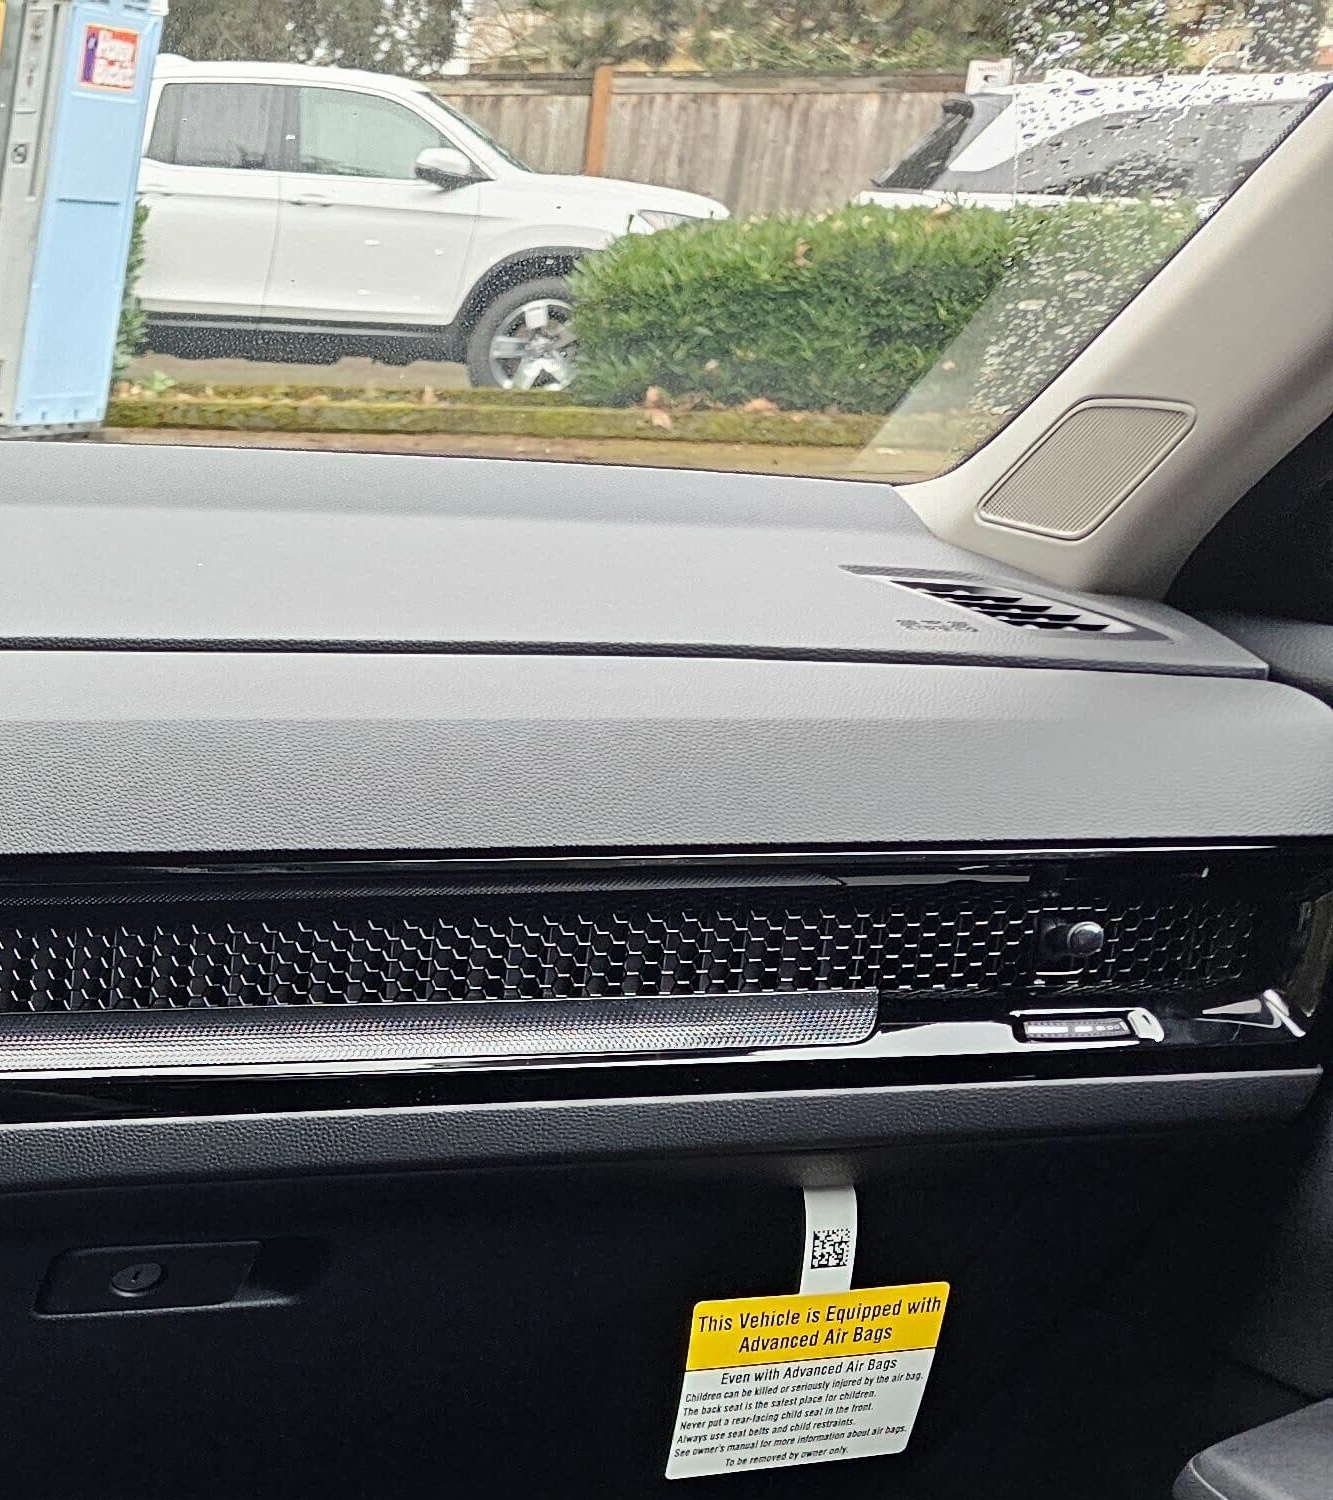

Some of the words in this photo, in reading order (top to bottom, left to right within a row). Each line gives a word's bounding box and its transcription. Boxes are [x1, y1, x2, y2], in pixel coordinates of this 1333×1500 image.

[699, 1315, 732, 1332] This
[740, 1309, 800, 1328] Vehicle
[807, 1308, 820, 1323] is
[826, 1300, 902, 1324] Equipped
[908, 1296, 941, 1314] with
[739, 1330, 819, 1353] Advanced
[823, 1329, 848, 1345] Air
[853, 1327, 892, 1343] Bags
[721, 1373, 750, 1384] Even
[755, 1368, 779, 1381] with
[783, 1362, 843, 1379] Advanced
[846, 1360, 864, 1372] Air
[868, 1359, 897, 1371] Bags
[686, 1392, 721, 1402] Children
[724, 1390, 738, 1398] can
[754, 1385, 778, 1396] killed
[791, 1381, 830, 1392] seriously
[832, 1378, 861, 1389] injured
[864, 1377, 874, 1386] by
[877, 1375, 889, 1383] the
[906, 1372, 923, 1381] bag.
[684, 1408, 698, 1416] The
[701, 1405, 721, 1414] back
[724, 1403, 743, 1412] seat
[745, 1402, 752, 1410] is
[755, 1401, 768, 1409] the
[771, 1397, 797, 1407] safest
[799, 1395, 822, 1405] place
[825, 1394, 837, 1402] for
[839, 1390, 876, 1400] children.
[680, 1420, 706, 1430] Never
[708, 1419, 721, 1429] put
[732, 1413, 778, 1425] rear-facing
[781, 1411, 802, 1419] child
[805, 1409, 823, 1417] seat
[825, 1407, 833, 1415] in
[836, 1405, 849, 1414] the
[851, 1403, 873, 1412] front.
[674, 1449, 690, 1457] See
[693, 1444, 725, 1455] owner's
[727, 1441, 758, 1451] manual
[760, 1440, 771, 1448] for
[774, 1437, 795, 1446] more
[797, 1432, 845, 1443] information
[847, 1429, 870, 1438] about
[872, 1427, 883, 1435] air
[885, 1425, 906, 1434] bags.
[677, 1434, 707, 1444] Always
[710, 1432, 725, 1440] use
[728, 1429, 746, 1438] seat
[749, 1427, 769, 1436] belts
[772, 1425, 787, 1433] and
[790, 1422, 811, 1431] child
[813, 1418, 854, 1429] restraints.
[750, 1452, 787, 1464] removed
[789, 1451, 798, 1460] by
[801, 1448, 827, 1457] owner
[829, 1446, 848, 1454] only.
